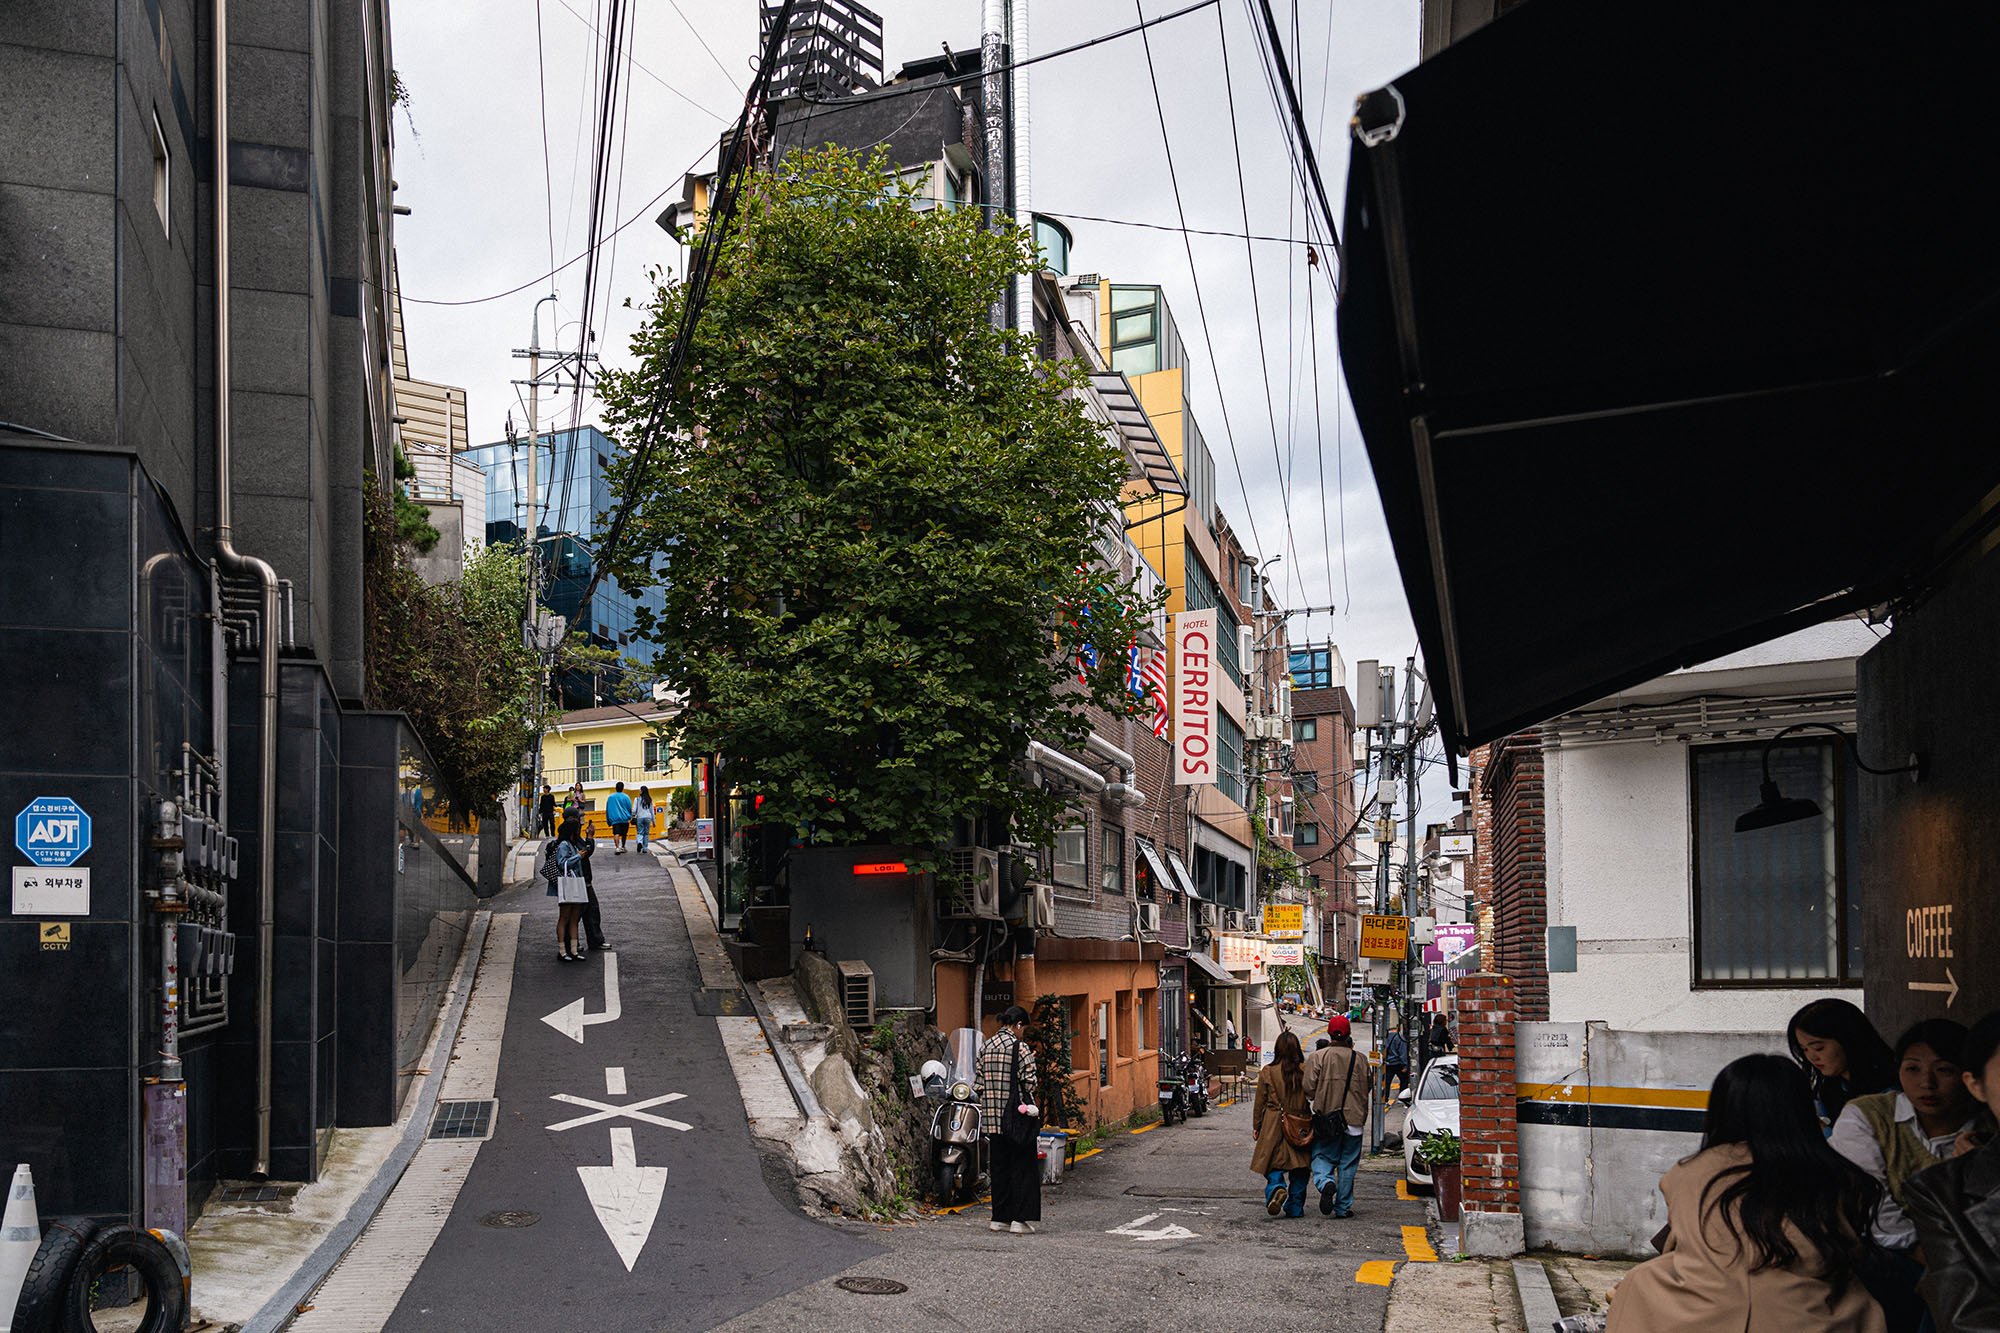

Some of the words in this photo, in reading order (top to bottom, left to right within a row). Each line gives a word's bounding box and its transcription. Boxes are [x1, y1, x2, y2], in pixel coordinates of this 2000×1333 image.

[1183, 620, 1208, 629] HOTEL
[1183, 631, 1209, 774] CERRITOS
[28, 819, 79, 843] ADT
[1365, 917, 1406, 930] 막다른길
[1906, 904, 1953, 958] COFFEE
[1363, 936, 1405, 950] 연결도로없음
